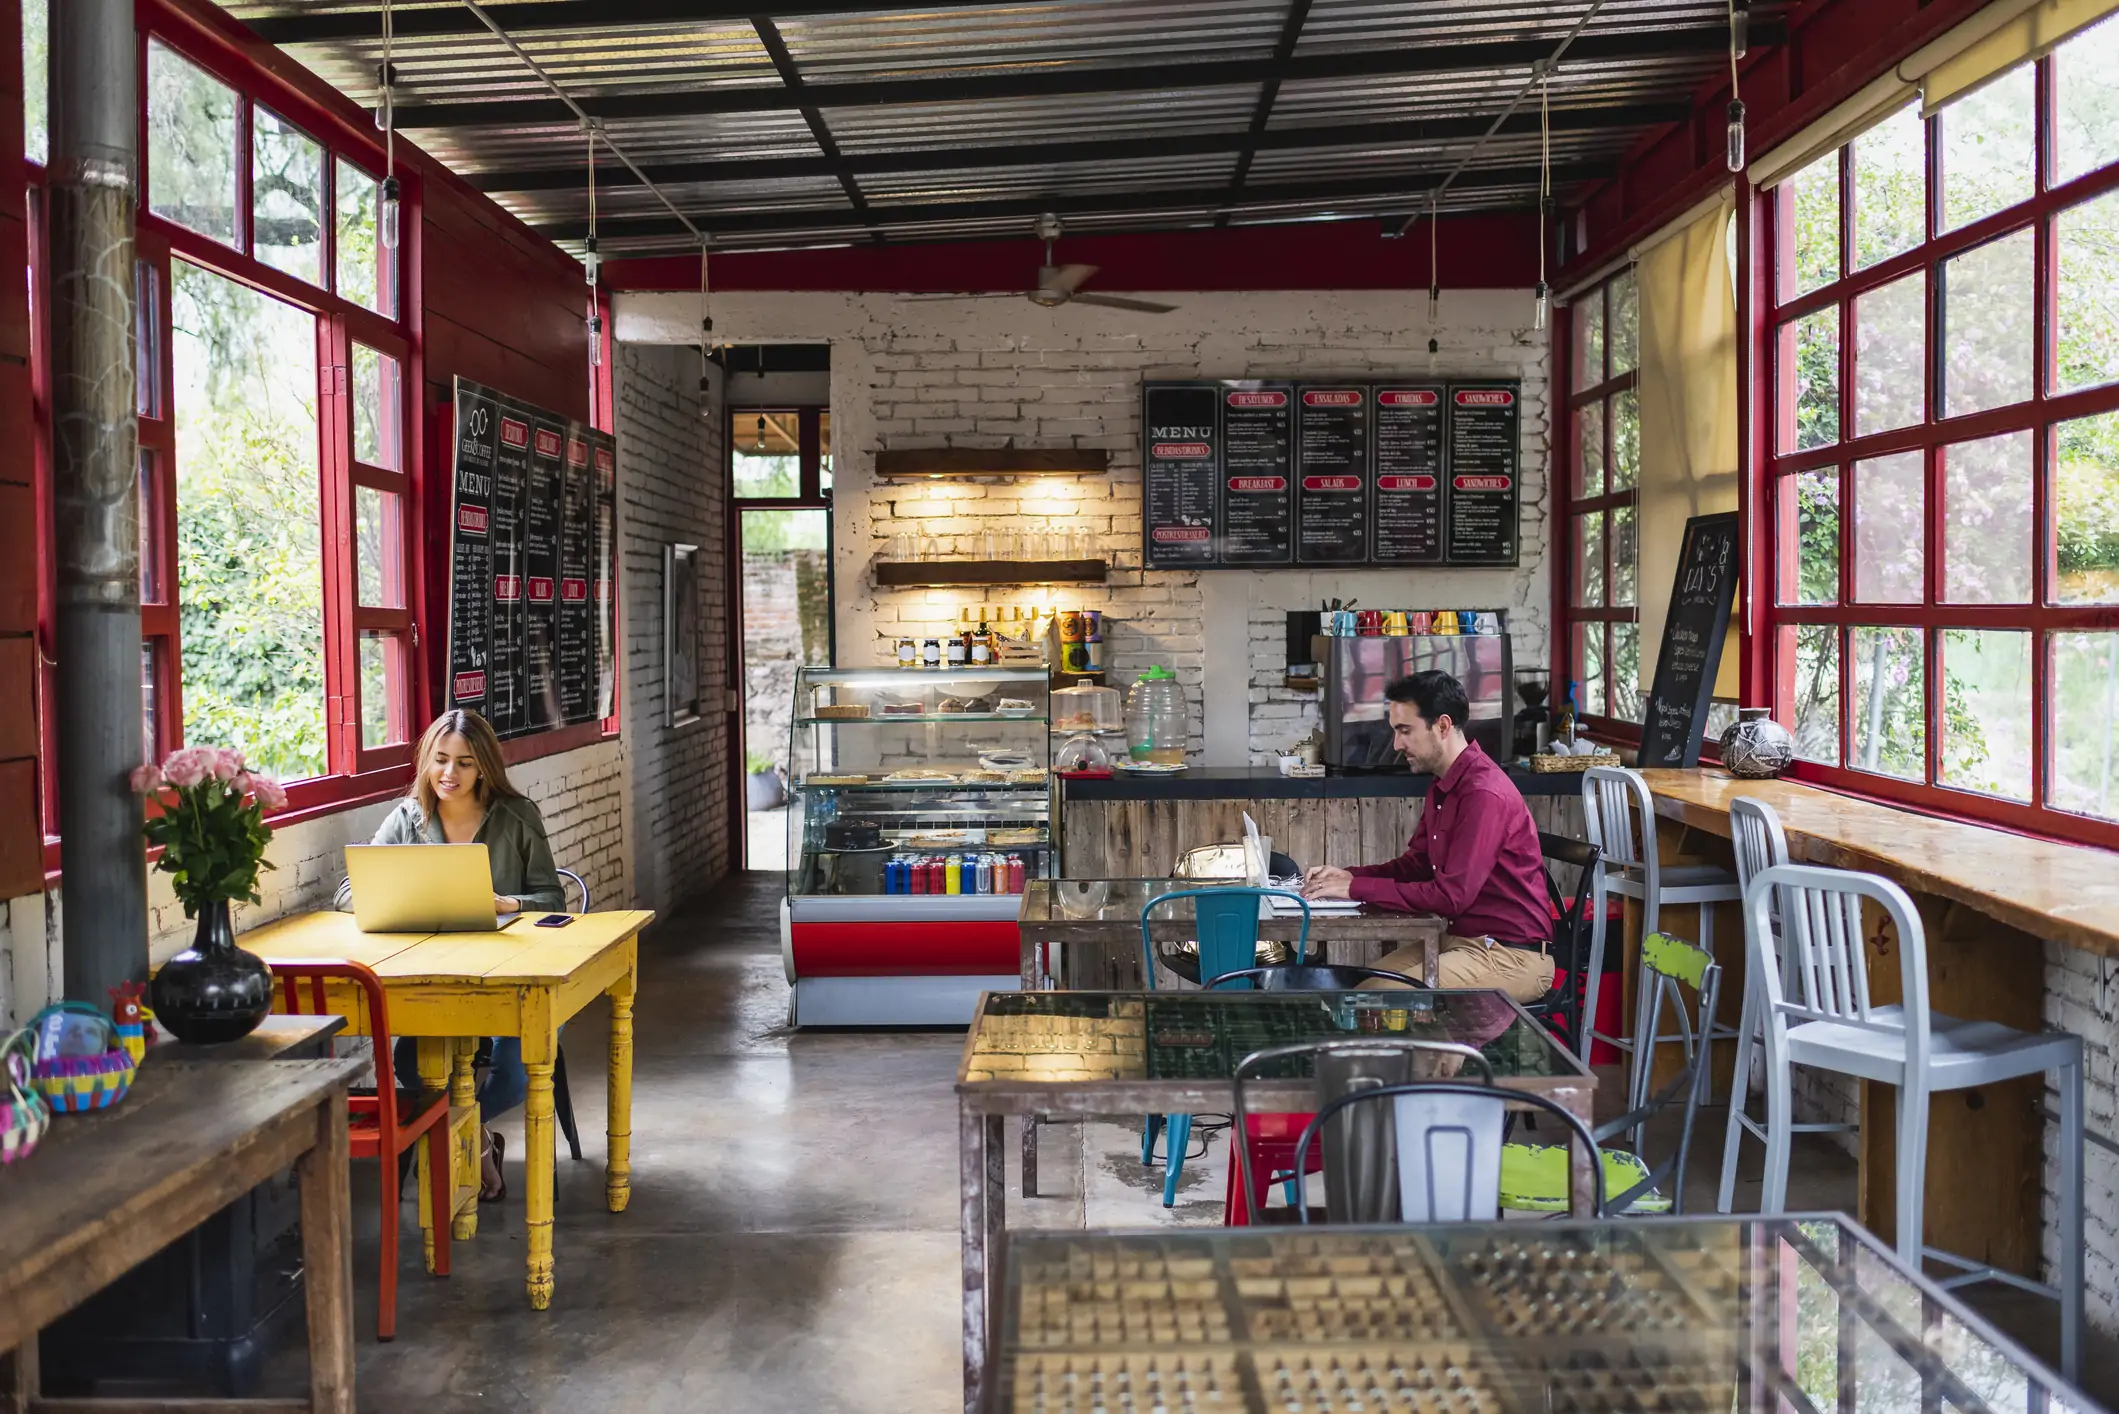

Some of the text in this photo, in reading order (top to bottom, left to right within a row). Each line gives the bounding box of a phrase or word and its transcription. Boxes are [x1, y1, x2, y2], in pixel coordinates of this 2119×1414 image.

[1314, 394, 1350, 403] ENSALADAS
[1151, 426, 1213, 439] MENU
[459, 470, 491, 497] MENU
[1239, 479, 1275, 489] BREAKFAST
[1321, 478, 1345, 488] SALADS
[1396, 478, 1418, 488] LUNCH
